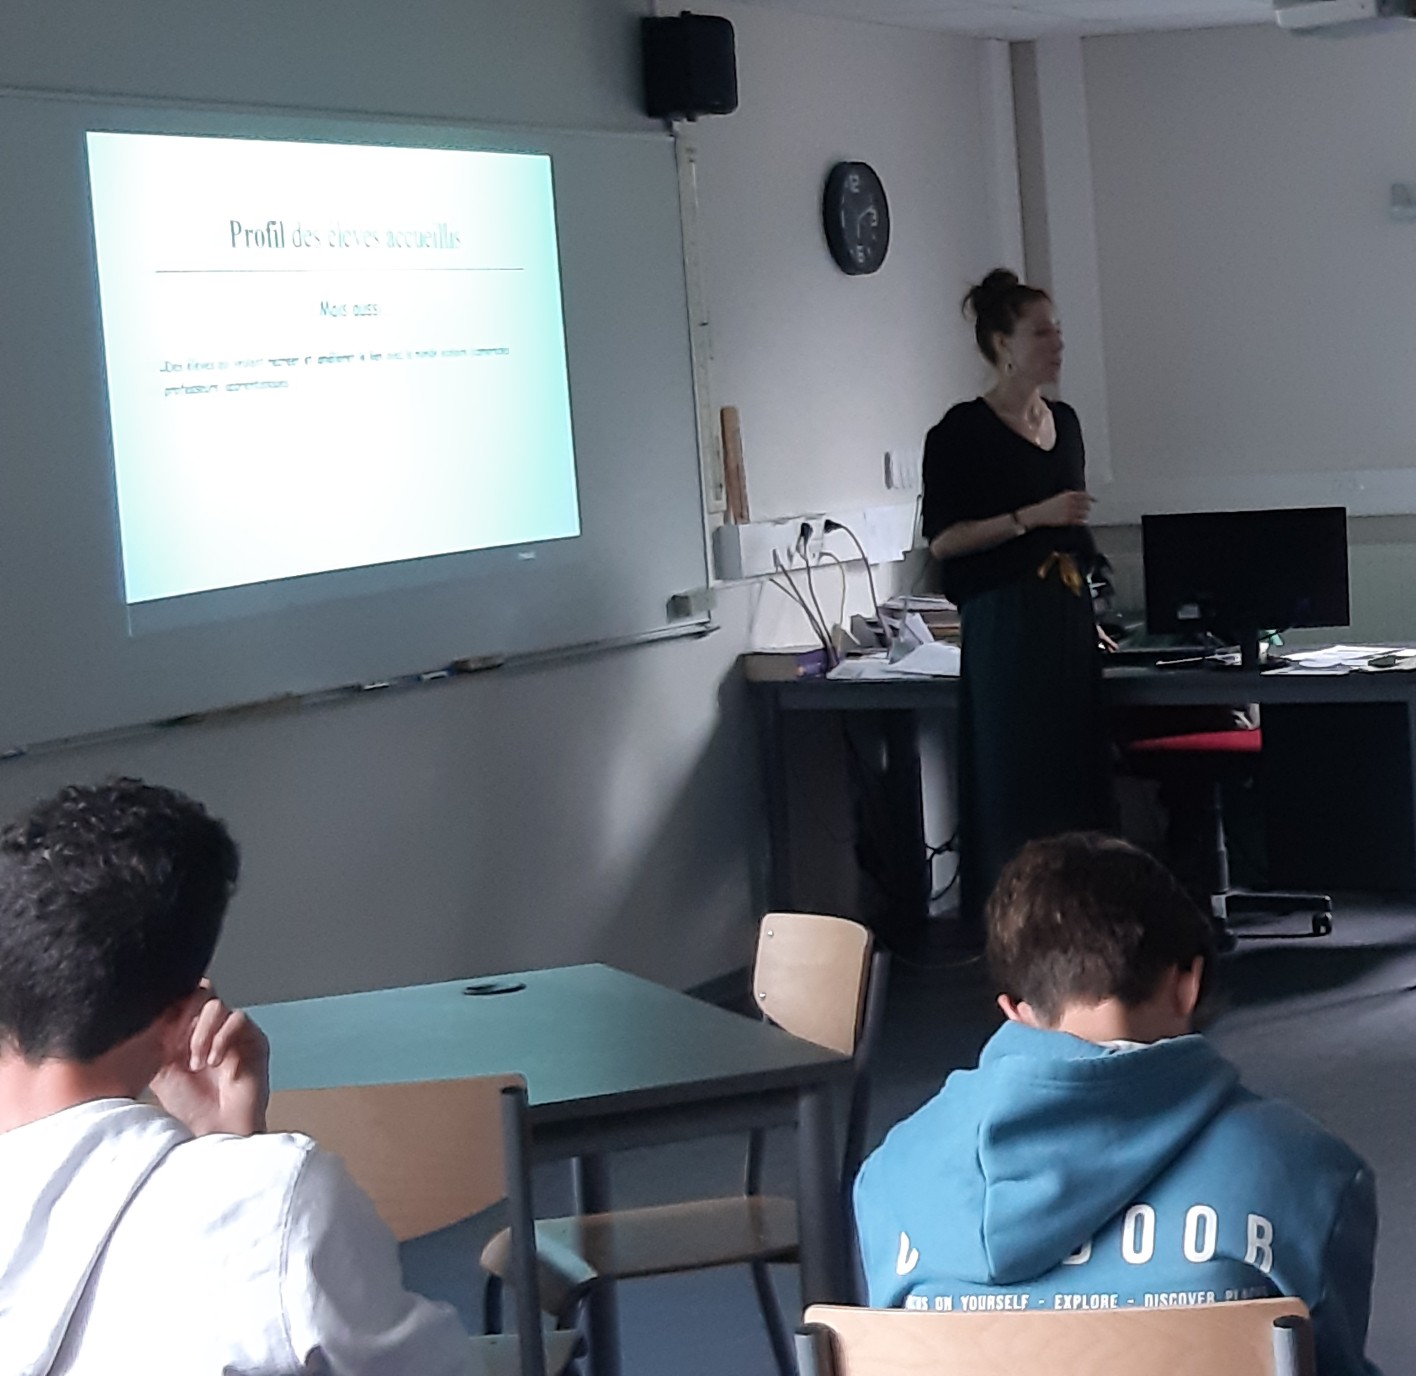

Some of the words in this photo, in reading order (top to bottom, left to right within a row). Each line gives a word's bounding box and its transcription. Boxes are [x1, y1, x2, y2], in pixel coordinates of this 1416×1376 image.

[230, 219, 286, 249] Profil
[292, 220, 321, 249] des
[935, 1295, 953, 1311] ON
[959, 1294, 1031, 1311] YOURSELF
[1054, 1293, 1118, 1310] EXPLORE
[1144, 1291, 1215, 1307] DISCOVER
